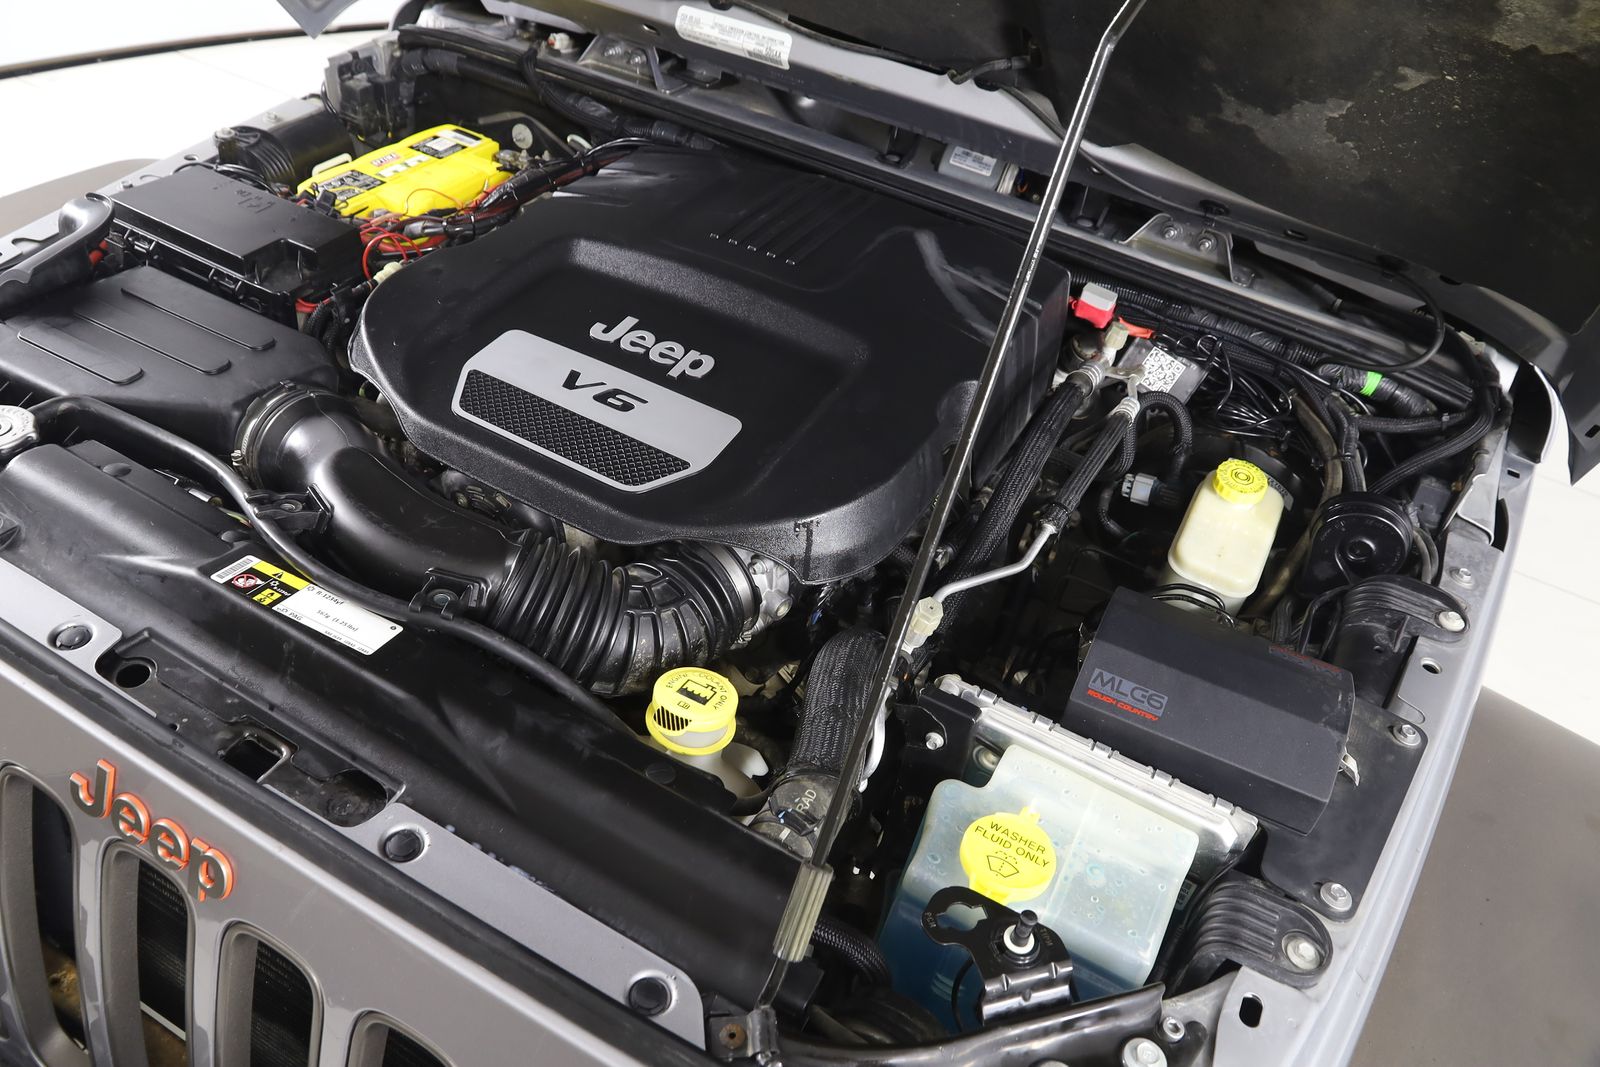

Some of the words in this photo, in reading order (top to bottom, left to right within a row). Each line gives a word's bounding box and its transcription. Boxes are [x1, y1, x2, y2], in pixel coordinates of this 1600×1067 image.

[589, 315, 715, 381] Jeep
[562, 369, 649, 412] V6
[666, 672, 688, 689] ENGINE
[713, 695, 728, 710] ONLY
[796, 788, 818, 814] RAD
[69, 758, 235, 903] Jeep
[974, 825, 1013, 850] FLUID
[1015, 846, 1050, 869] ONLY
[990, 821, 1047, 855] WASHER
